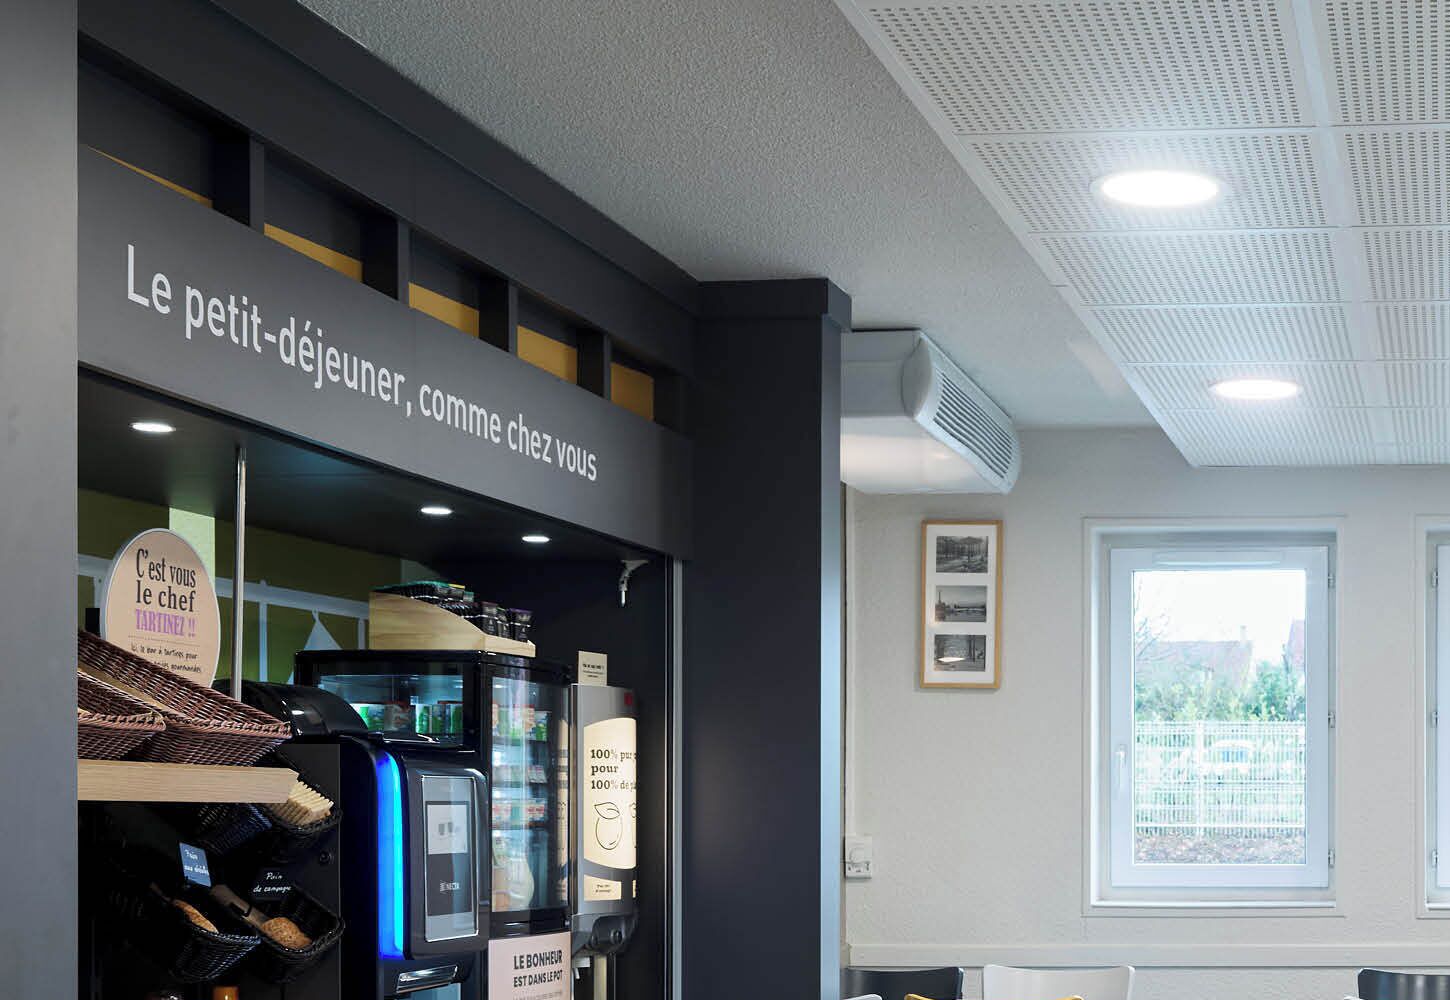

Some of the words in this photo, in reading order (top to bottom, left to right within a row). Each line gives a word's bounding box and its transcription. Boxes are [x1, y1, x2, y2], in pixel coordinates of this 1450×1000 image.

[127, 244, 172, 315] Le
[185, 284, 412, 417] petit-déjeuner,
[419, 383, 501, 444] comme
[507, 413, 552, 463] chez
[556, 438, 597, 481] vous
[136, 549, 165, 582] C'est
[169, 565, 196, 588] vous
[136, 580, 152, 604] le
[159, 586, 196, 612] chef
[135, 608, 185, 637] TARTINEZ
[590, 764, 619, 776] pour
[266, 872, 282, 880] Pain
[513, 955, 525, 970] LE
[526, 949, 563, 969] BONHEUR
[513, 976, 528, 988] EST
[528, 972, 546, 986] DANS
[547, 971, 553, 982] LE
[553, 969, 563, 981] POT
